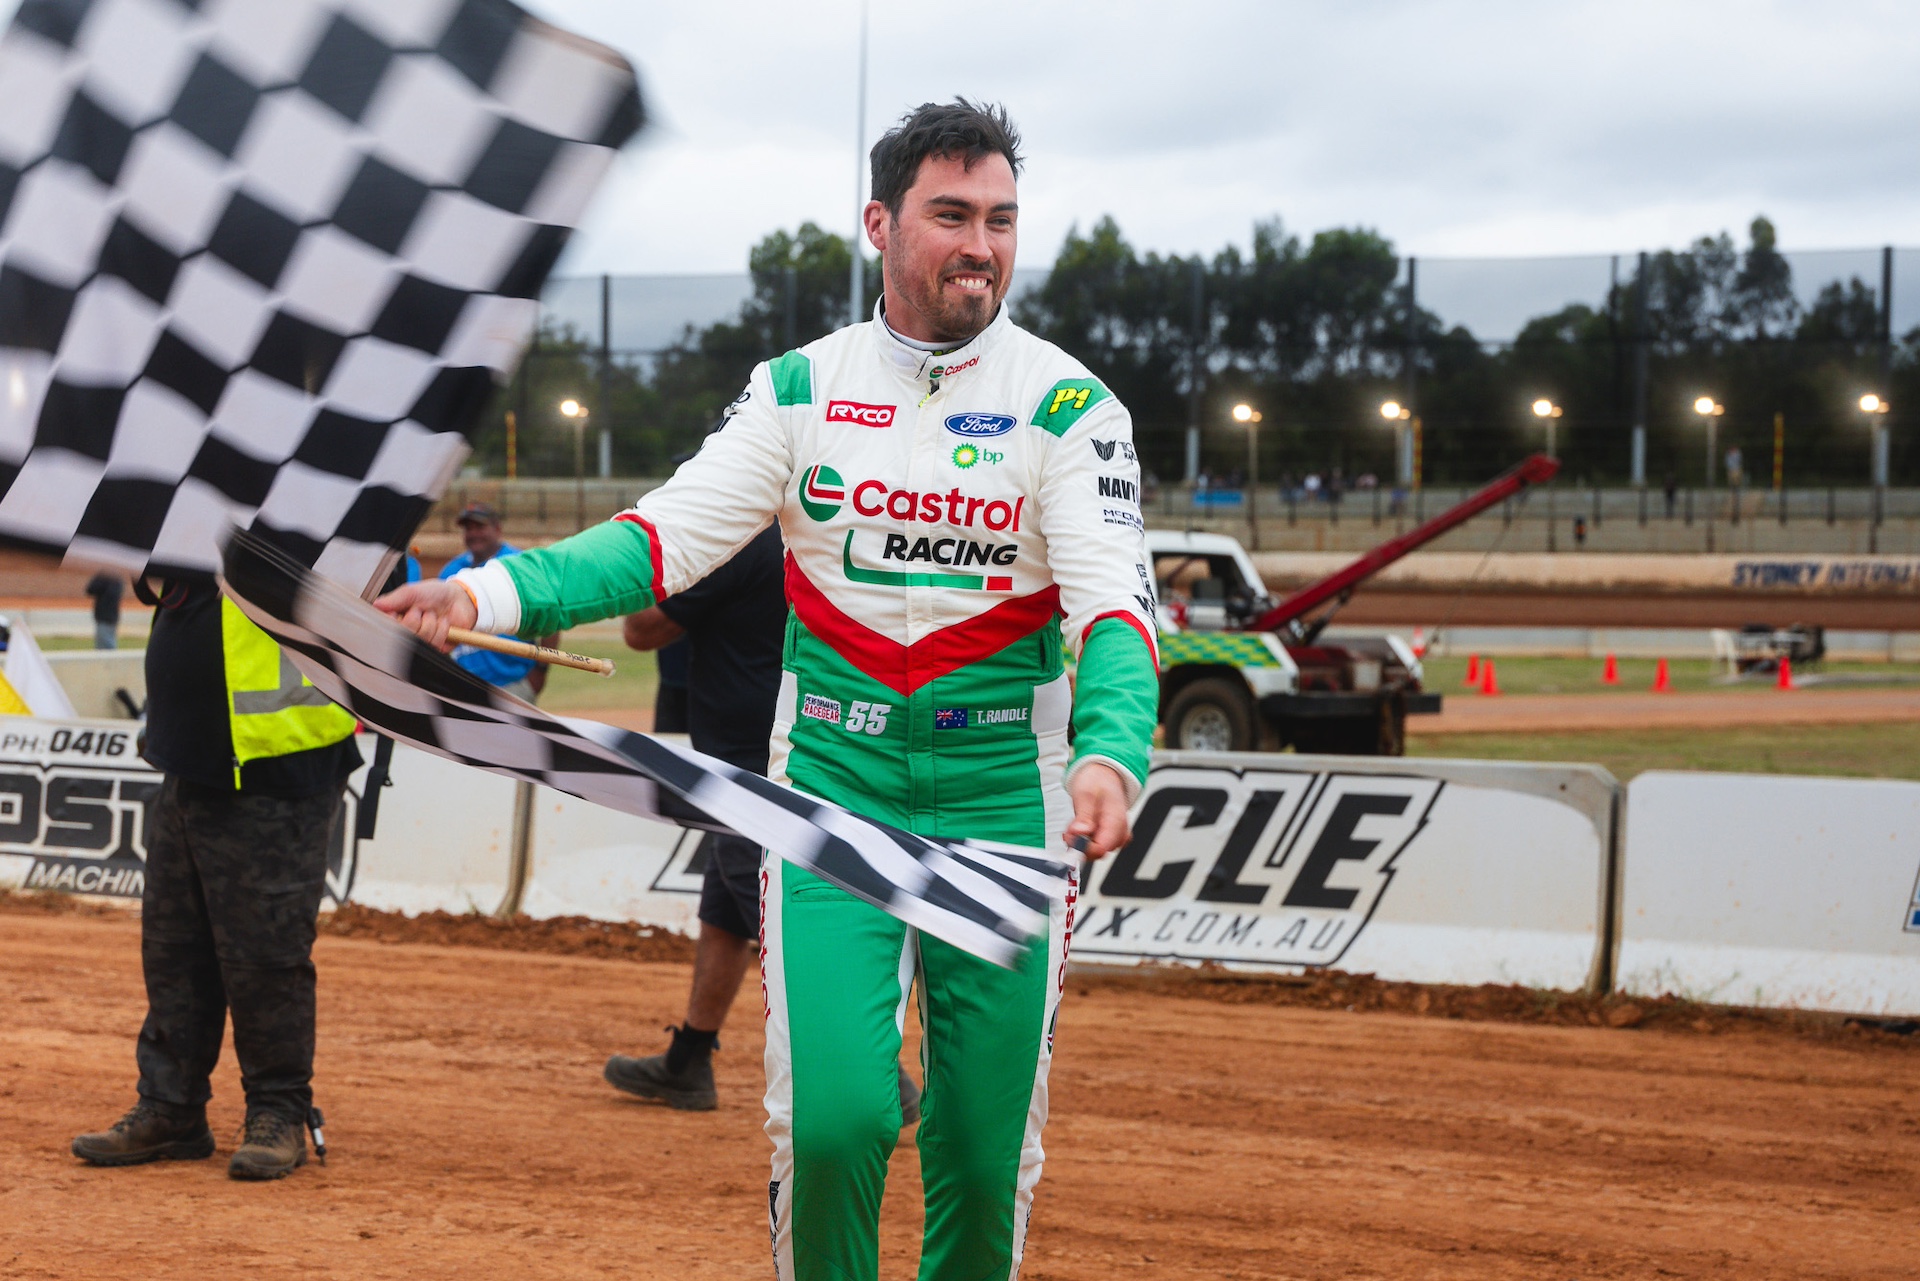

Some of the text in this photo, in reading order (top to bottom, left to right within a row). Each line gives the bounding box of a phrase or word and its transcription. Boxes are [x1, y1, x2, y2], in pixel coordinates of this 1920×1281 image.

[945, 354, 981, 376] Castrol
[1047, 387, 1092, 416] P1
[830, 404, 892, 424] RYCO
[960, 415, 1003, 432] Ford
[983, 448, 1004, 465] bp
[852, 479, 1026, 532] Castrol
[882, 533, 1018, 567] RACING
[1734, 562, 1821, 586] SYDNEY
[804, 703, 840, 722] RACEGEAR
[805, 696, 840, 711] PERFORMANCE
[845, 700, 892, 735] 55
[51, 730, 129, 756] 0416
